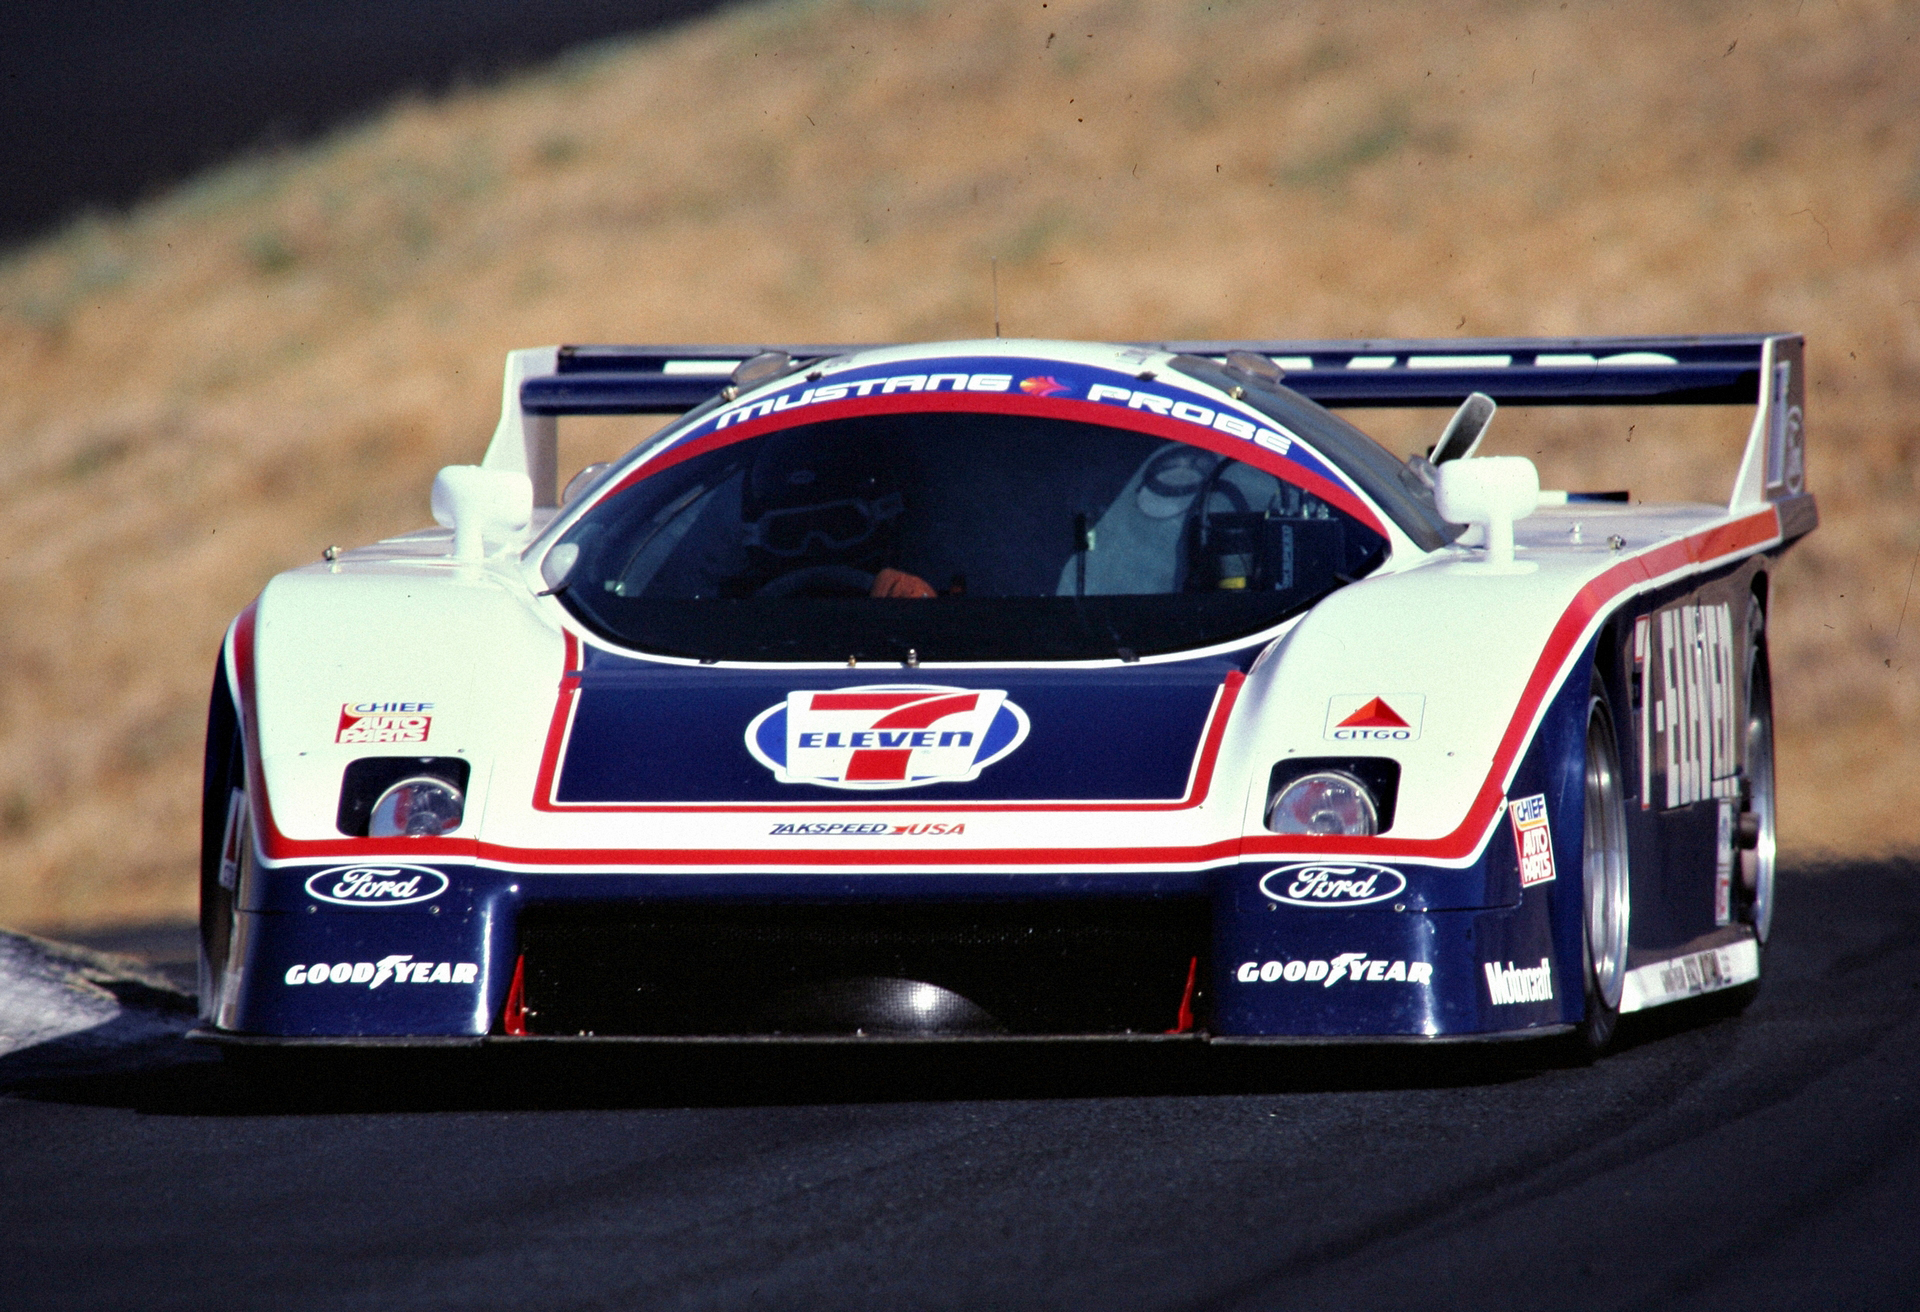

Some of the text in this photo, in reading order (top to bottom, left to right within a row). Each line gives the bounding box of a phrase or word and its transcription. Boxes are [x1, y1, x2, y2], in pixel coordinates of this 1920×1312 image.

[716, 373, 1291, 455] MUSTANG PROBE
[354, 702, 434, 713] CHIEF
[357, 716, 428, 730] AUTO
[338, 728, 426, 743] PARTS
[809, 692, 979, 781] 7
[1334, 729, 1411, 741] CITGO
[1516, 798, 1545, 823] CHIEF
[768, 823, 966, 836] ZAKSPEED USA
[1522, 827, 1549, 858] AUTO
[1522, 850, 1552, 882] PARTS
[332, 868, 422, 898] Ford
[1288, 867, 1377, 898] Ford
[285, 954, 479, 990] GOODYEAR
[1237, 952, 1434, 988] GOODYEAR
[1485, 957, 1553, 1005] Motorcraft
